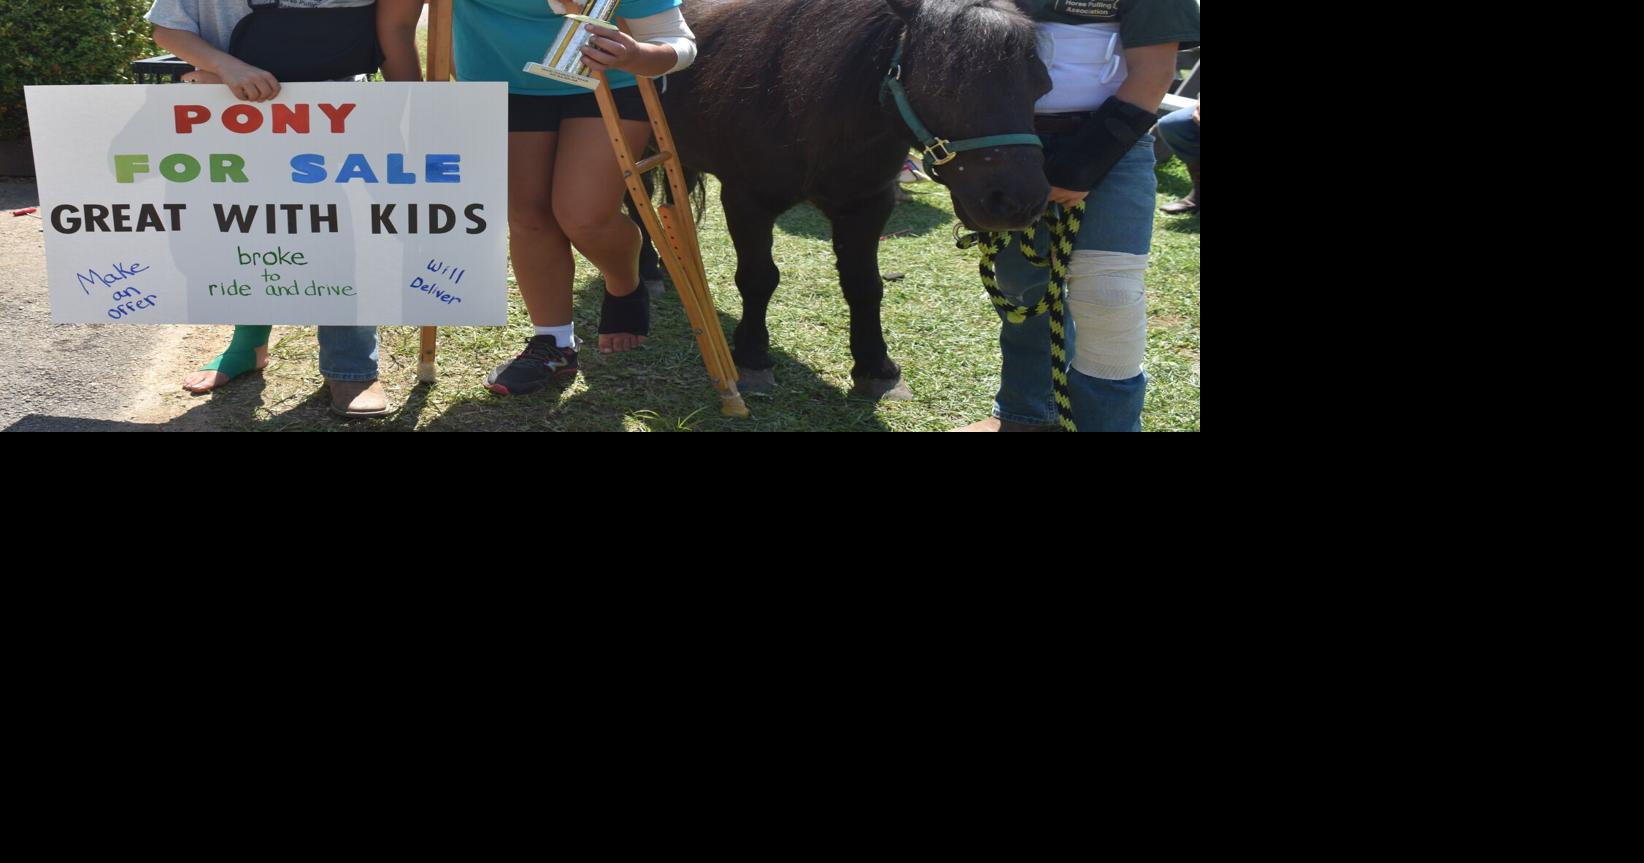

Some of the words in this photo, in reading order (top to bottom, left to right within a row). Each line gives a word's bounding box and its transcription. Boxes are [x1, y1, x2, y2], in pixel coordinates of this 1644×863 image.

[1066, 6, 1109, 15] Association
[174, 103, 357, 134] PONY
[114, 153, 249, 184] FOR
[290, 153, 461, 184] SALE
[50, 203, 187, 234] GREAT
[213, 203, 339, 234] WITH
[370, 203, 487, 235] KIDS
[237, 245, 308, 266] broke
[76, 262, 150, 295] Make
[261, 268, 281, 282] to
[426, 259, 465, 284] Will
[112, 286, 141, 301] an
[208, 279, 252, 296] ride
[265, 280, 300, 296] and
[304, 280, 357, 296] drive
[409, 276, 462, 304] Deliver
